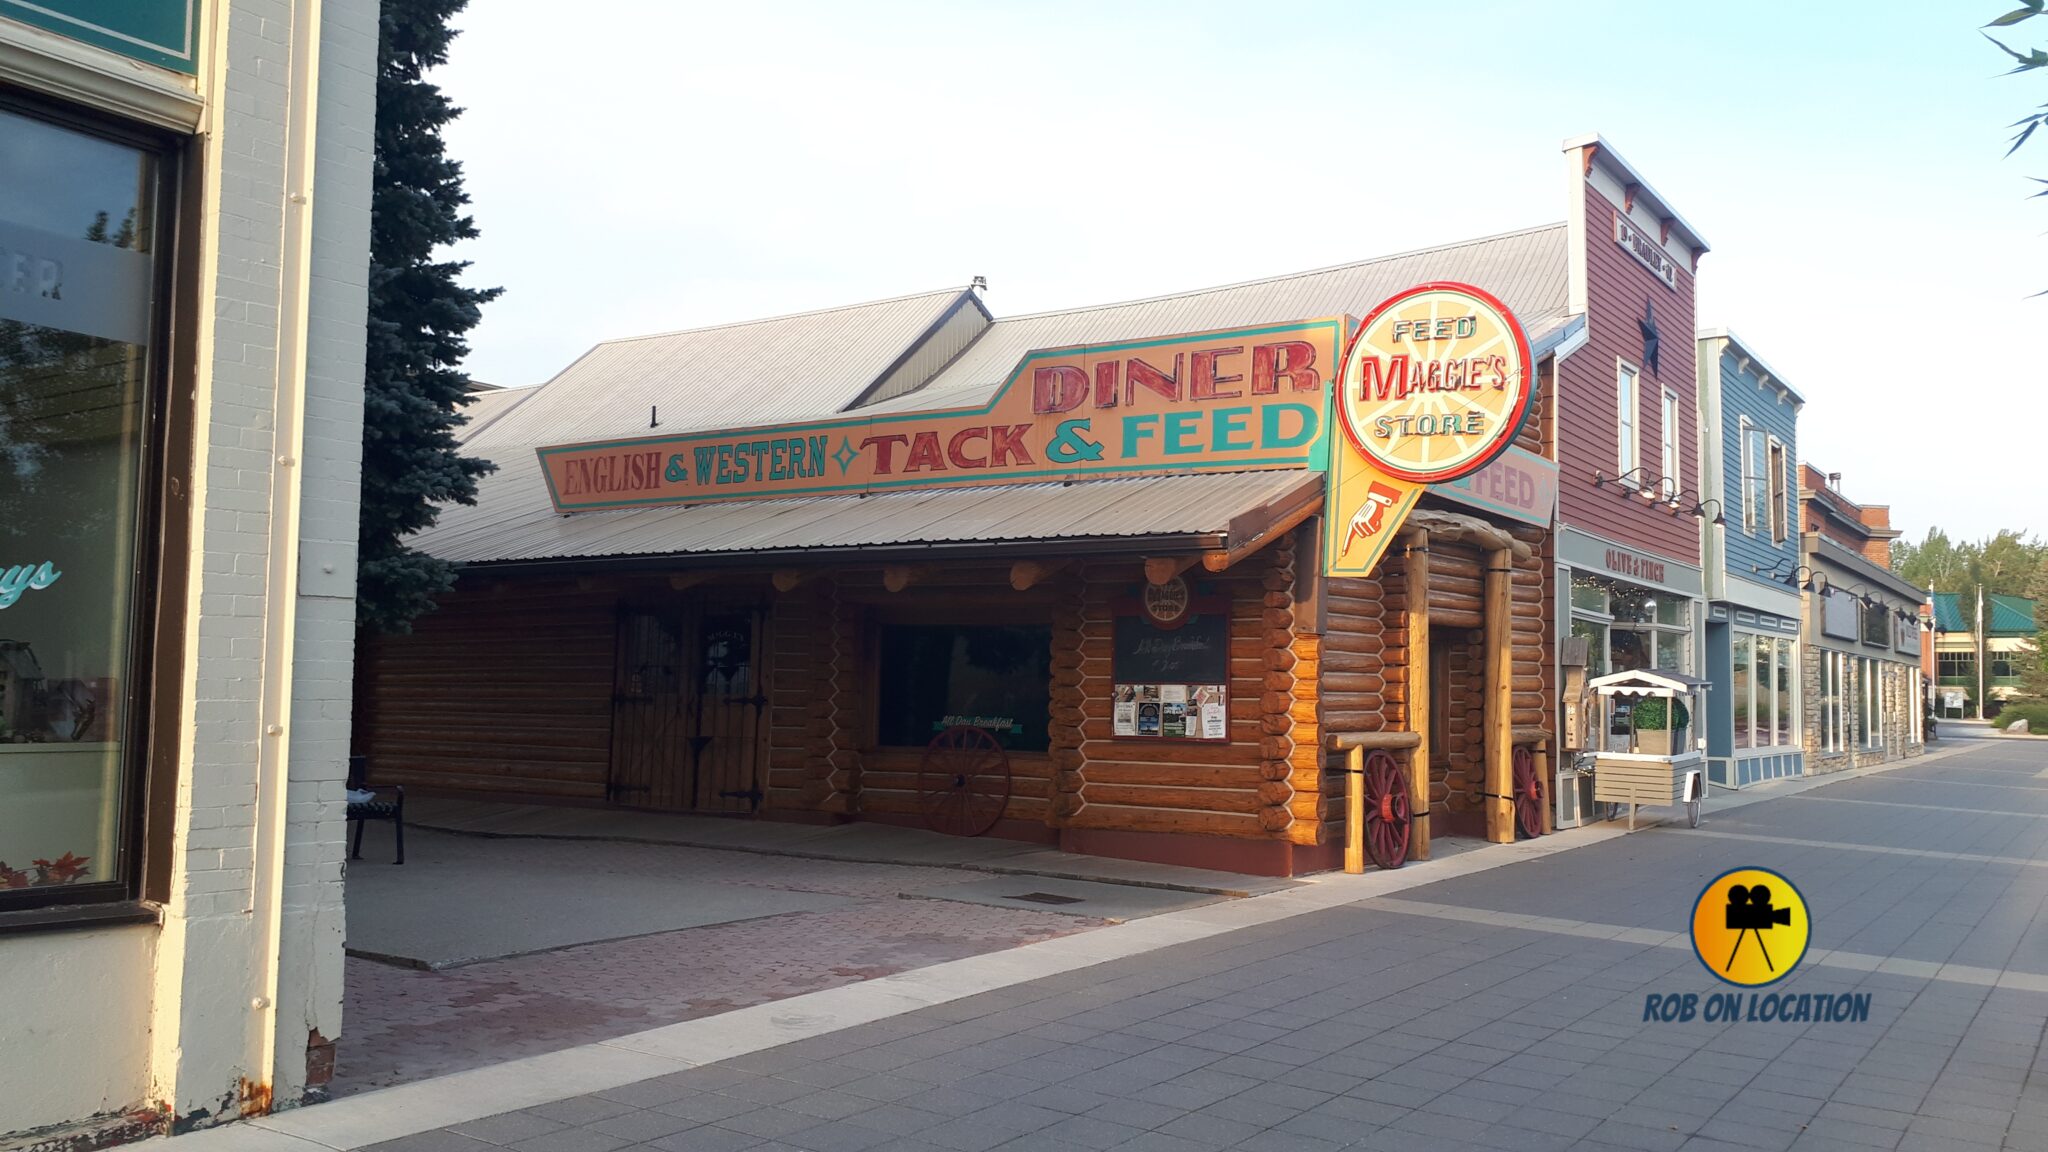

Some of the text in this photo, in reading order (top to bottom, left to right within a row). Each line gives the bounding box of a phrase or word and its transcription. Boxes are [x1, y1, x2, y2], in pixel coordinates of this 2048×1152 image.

[1392, 316, 1477, 343] FEED
[1031, 340, 1320, 415] DINER
[1359, 354, 1506, 401] MAGGIE'S
[859, 403, 1320, 475] TACK & FEED
[1374, 411, 1486, 438] STORE
[562, 435, 828, 495] ENGLISH & WESTERN
[0, 561, 62, 609] ys
[1606, 549, 1632, 575] OLIVE
[1641, 559, 1665, 583] FINCH
